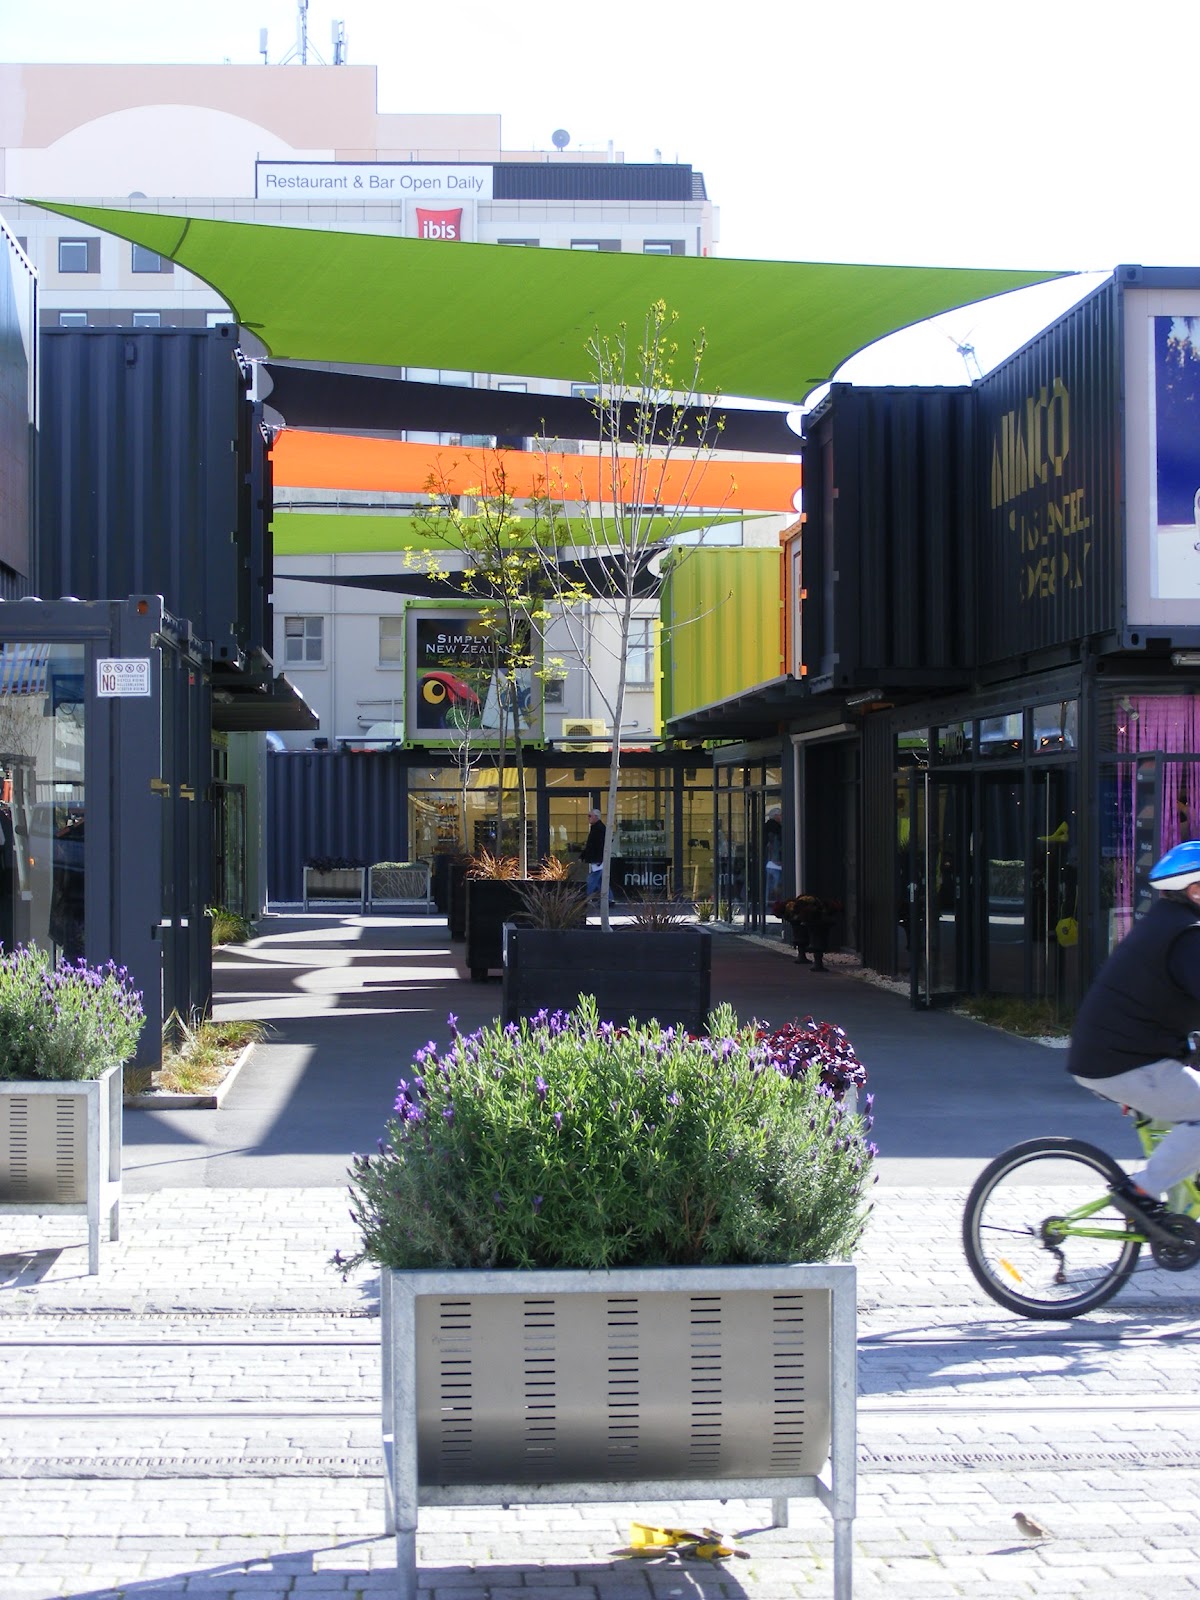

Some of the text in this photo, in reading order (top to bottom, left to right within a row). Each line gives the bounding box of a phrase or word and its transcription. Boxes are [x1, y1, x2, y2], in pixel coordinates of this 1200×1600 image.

[266, 174, 484, 192] Restaurant & Bar Open Daily
[423, 220, 456, 239] ibis
[437, 634, 490, 644] SIMPLY
[426, 644, 457, 654] NEW
[103, 674, 115, 691] NO
